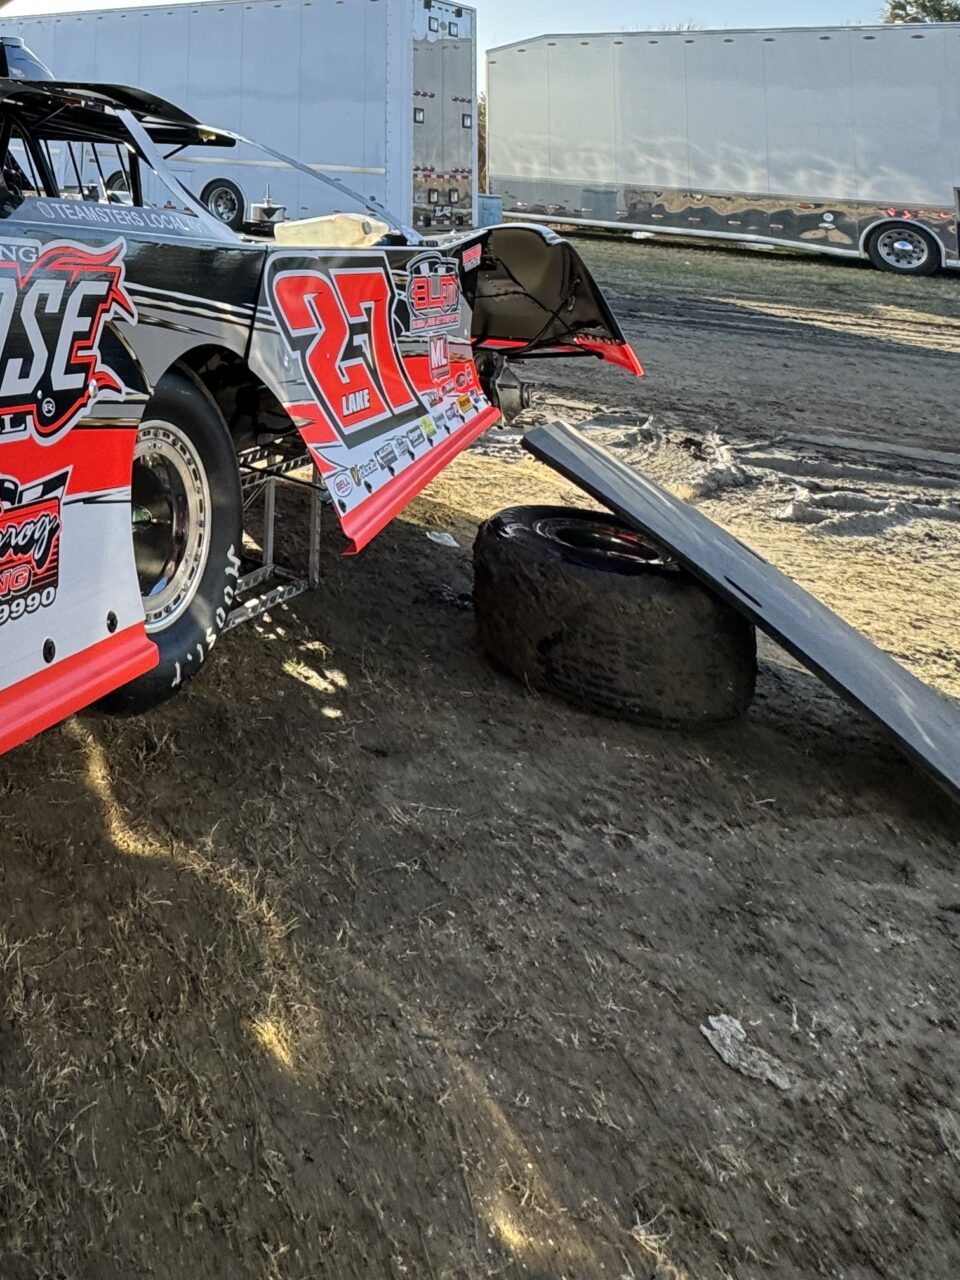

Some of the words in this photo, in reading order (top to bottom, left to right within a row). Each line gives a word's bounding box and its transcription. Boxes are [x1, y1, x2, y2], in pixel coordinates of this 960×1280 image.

[51, 203, 144, 226] TEAMSTERS
[144, 216, 191, 232] LOCAL
[273, 269, 415, 429] 27
[342, 389, 371, 417] LAKE
[335, 476, 350, 492] BELL
